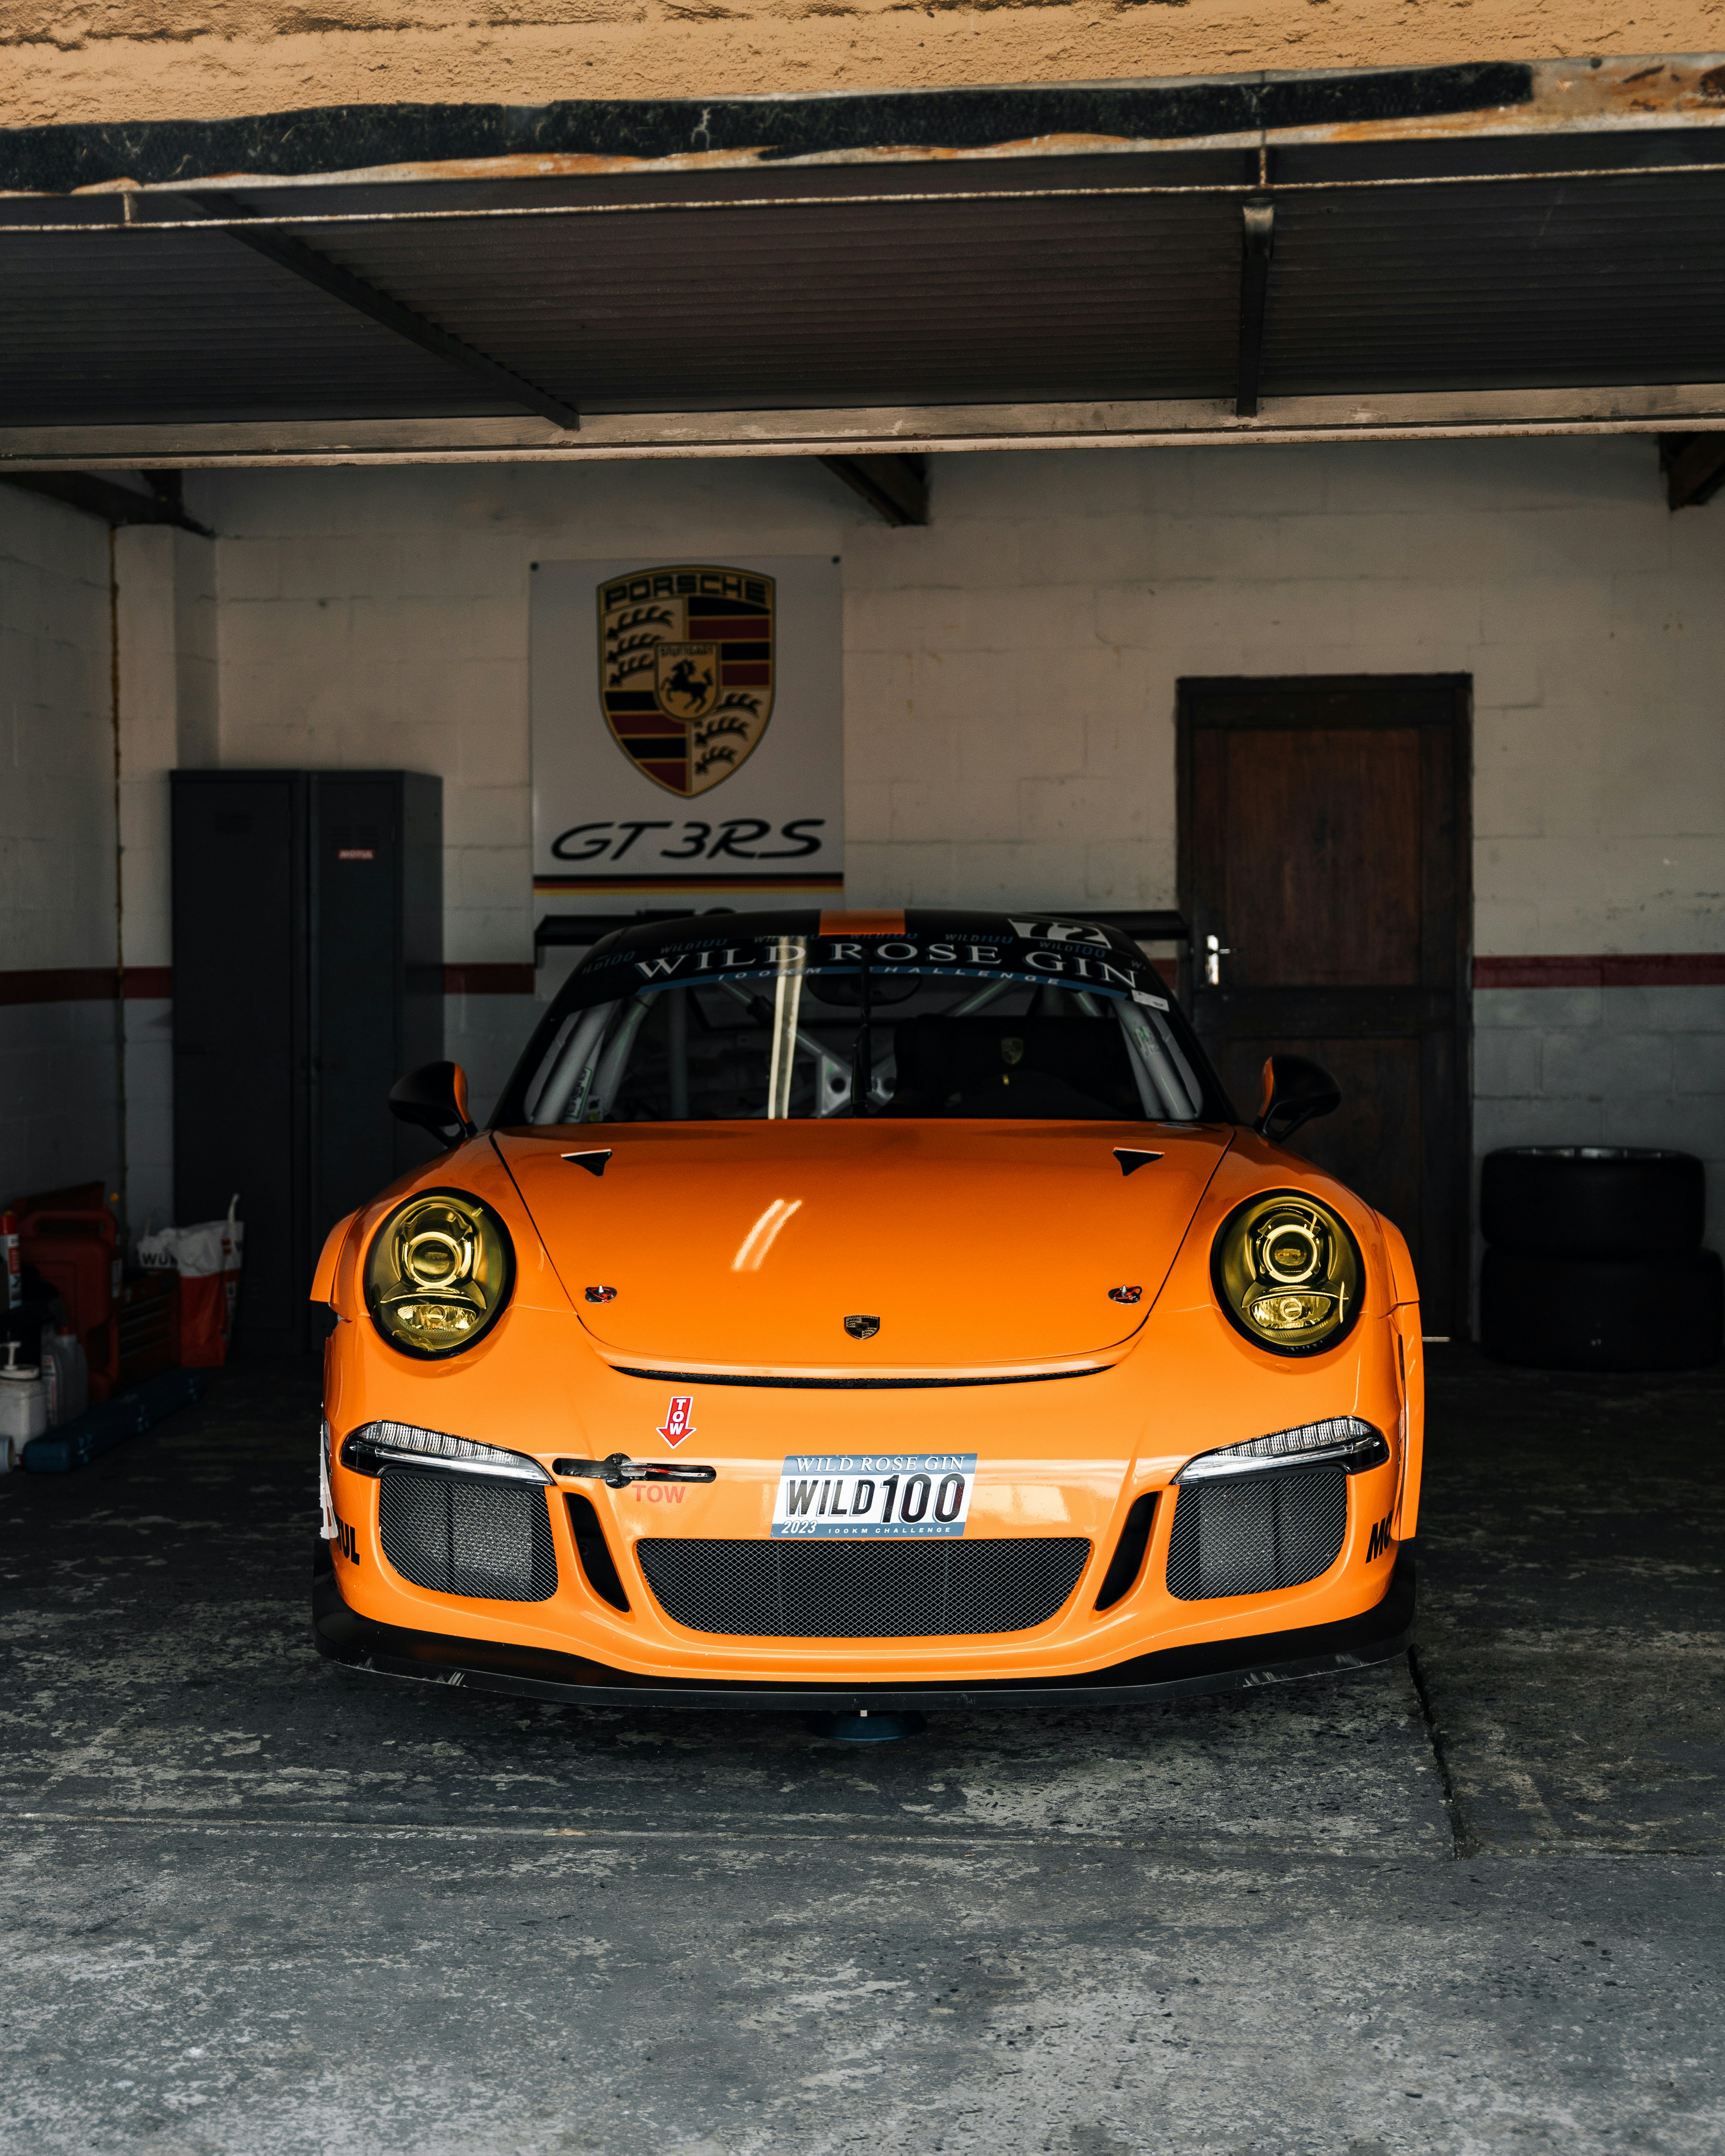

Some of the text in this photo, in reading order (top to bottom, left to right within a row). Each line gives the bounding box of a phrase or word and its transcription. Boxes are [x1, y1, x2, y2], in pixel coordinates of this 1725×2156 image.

[606, 575, 766, 610] PORSCHE
[1039, 941, 1106, 958] WILD100
[634, 942, 1138, 988] WILD ROSE GIN
[670, 1399, 687, 1435] TOW
[796, 1456, 965, 1472] WILD ROSE GIN
[632, 1485, 685, 1503] TOW
[786, 1473, 965, 1523] WILD100
[781, 1520, 818, 1534] 2023
